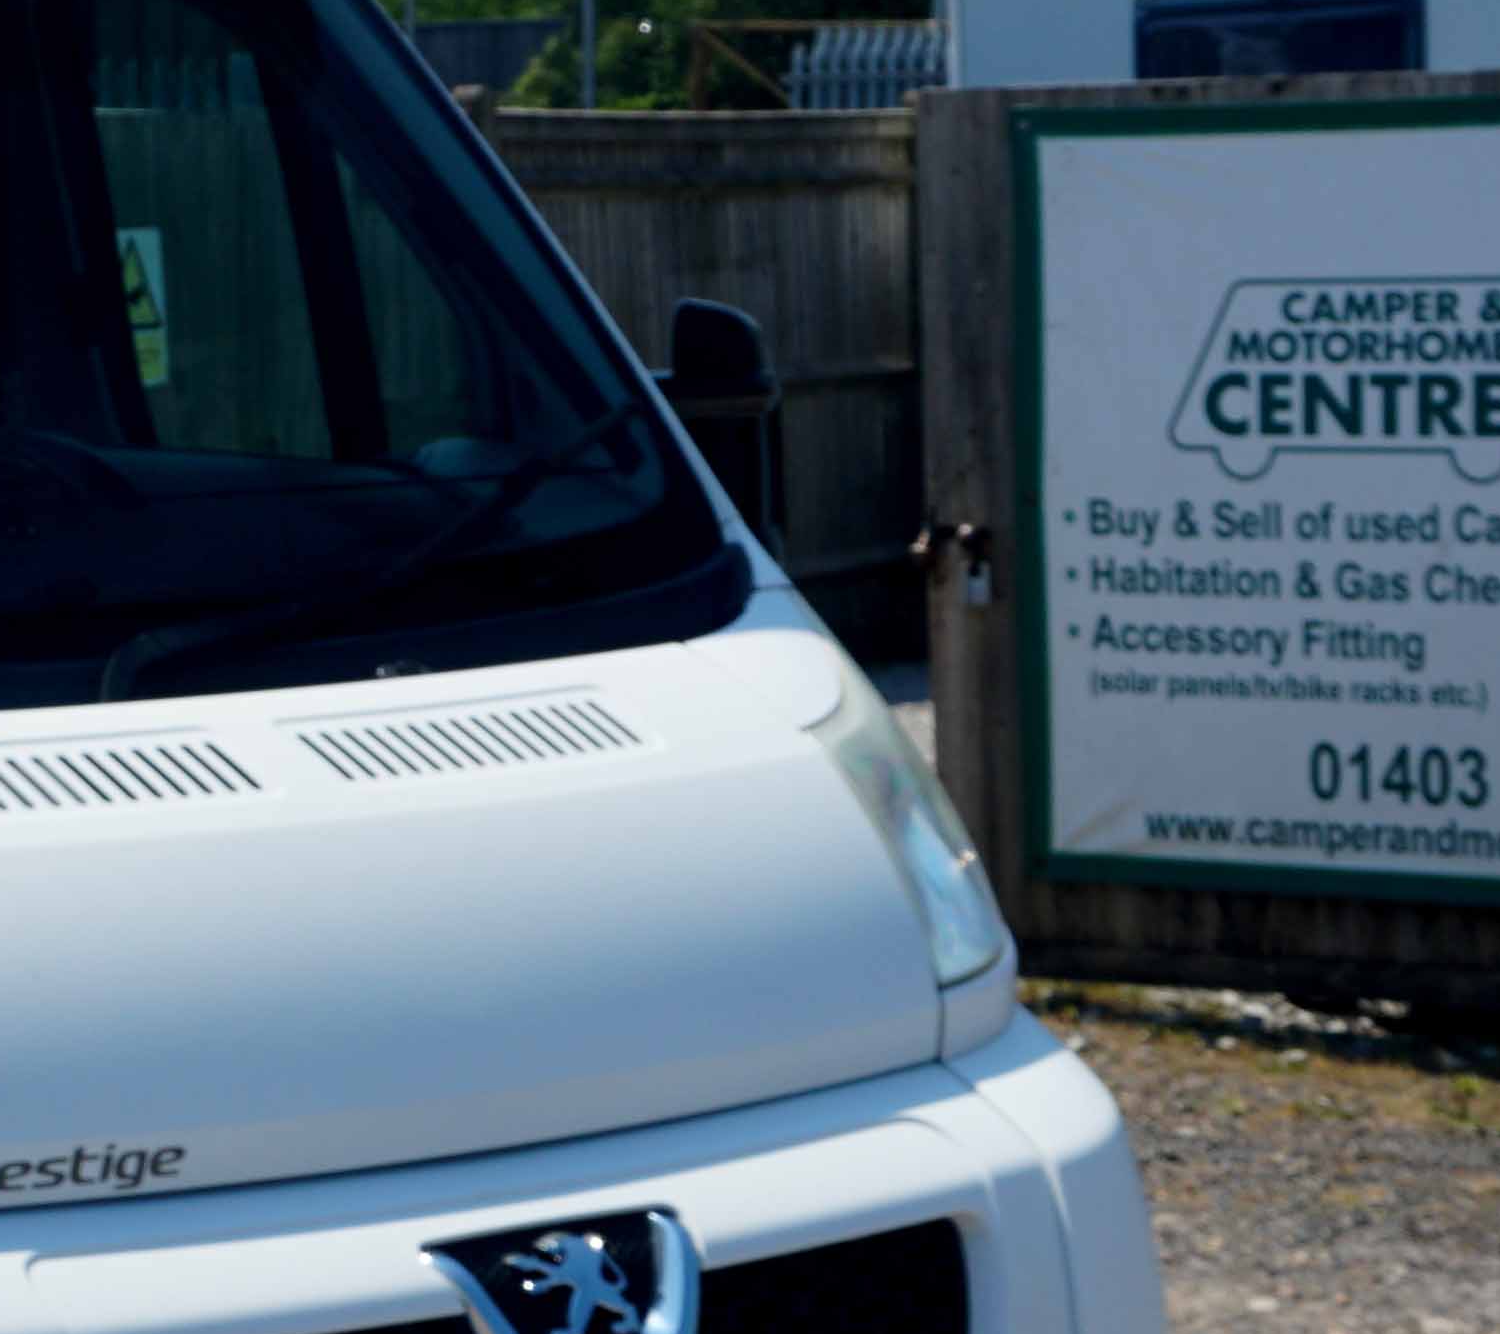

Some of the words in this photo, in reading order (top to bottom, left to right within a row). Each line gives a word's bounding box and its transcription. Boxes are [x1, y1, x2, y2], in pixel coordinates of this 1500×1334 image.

[1281, 290, 1460, 323] CAMPER
[1088, 498, 1160, 547] Buy
[1174, 499, 1200, 540] &
[1212, 500, 1284, 541] Sell
[1296, 501, 1336, 542] of
[1346, 503, 1440, 543] used
[1090, 557, 1282, 600] Habitation
[1295, 560, 1321, 600] &
[1334, 562, 1412, 603] Gas
[1091, 613, 1288, 667] Accessory
[1304, 618, 1426, 673] Fitting
[1090, 667, 1159, 698] (solar
[1350, 676, 1422, 706] racks
[1310, 740, 1489, 809] 01403
